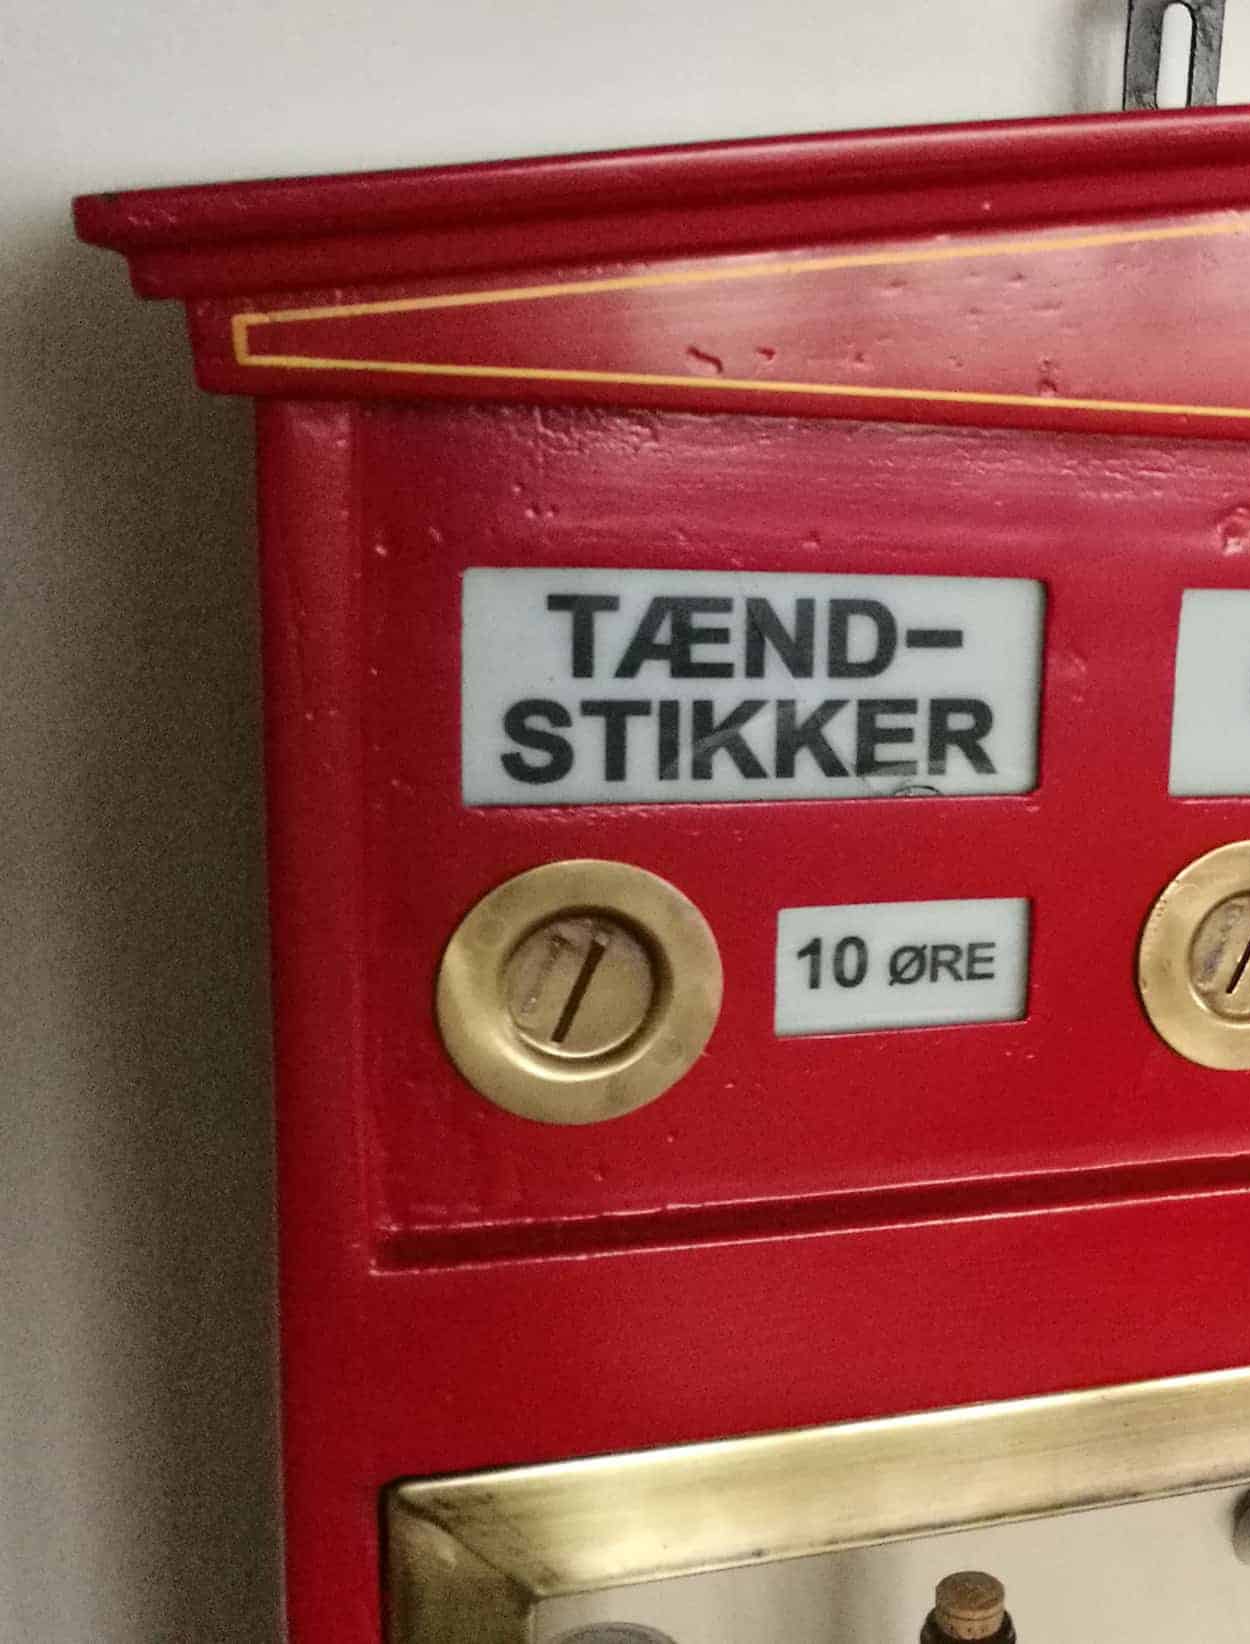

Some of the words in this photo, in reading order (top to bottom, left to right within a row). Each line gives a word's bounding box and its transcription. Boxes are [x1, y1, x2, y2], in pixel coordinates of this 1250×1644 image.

[546, 594, 963, 680] TÆND-
[500, 697, 997, 785] STIKKER
[796, 935, 869, 990] 10
[888, 941, 996, 986] ØRE
